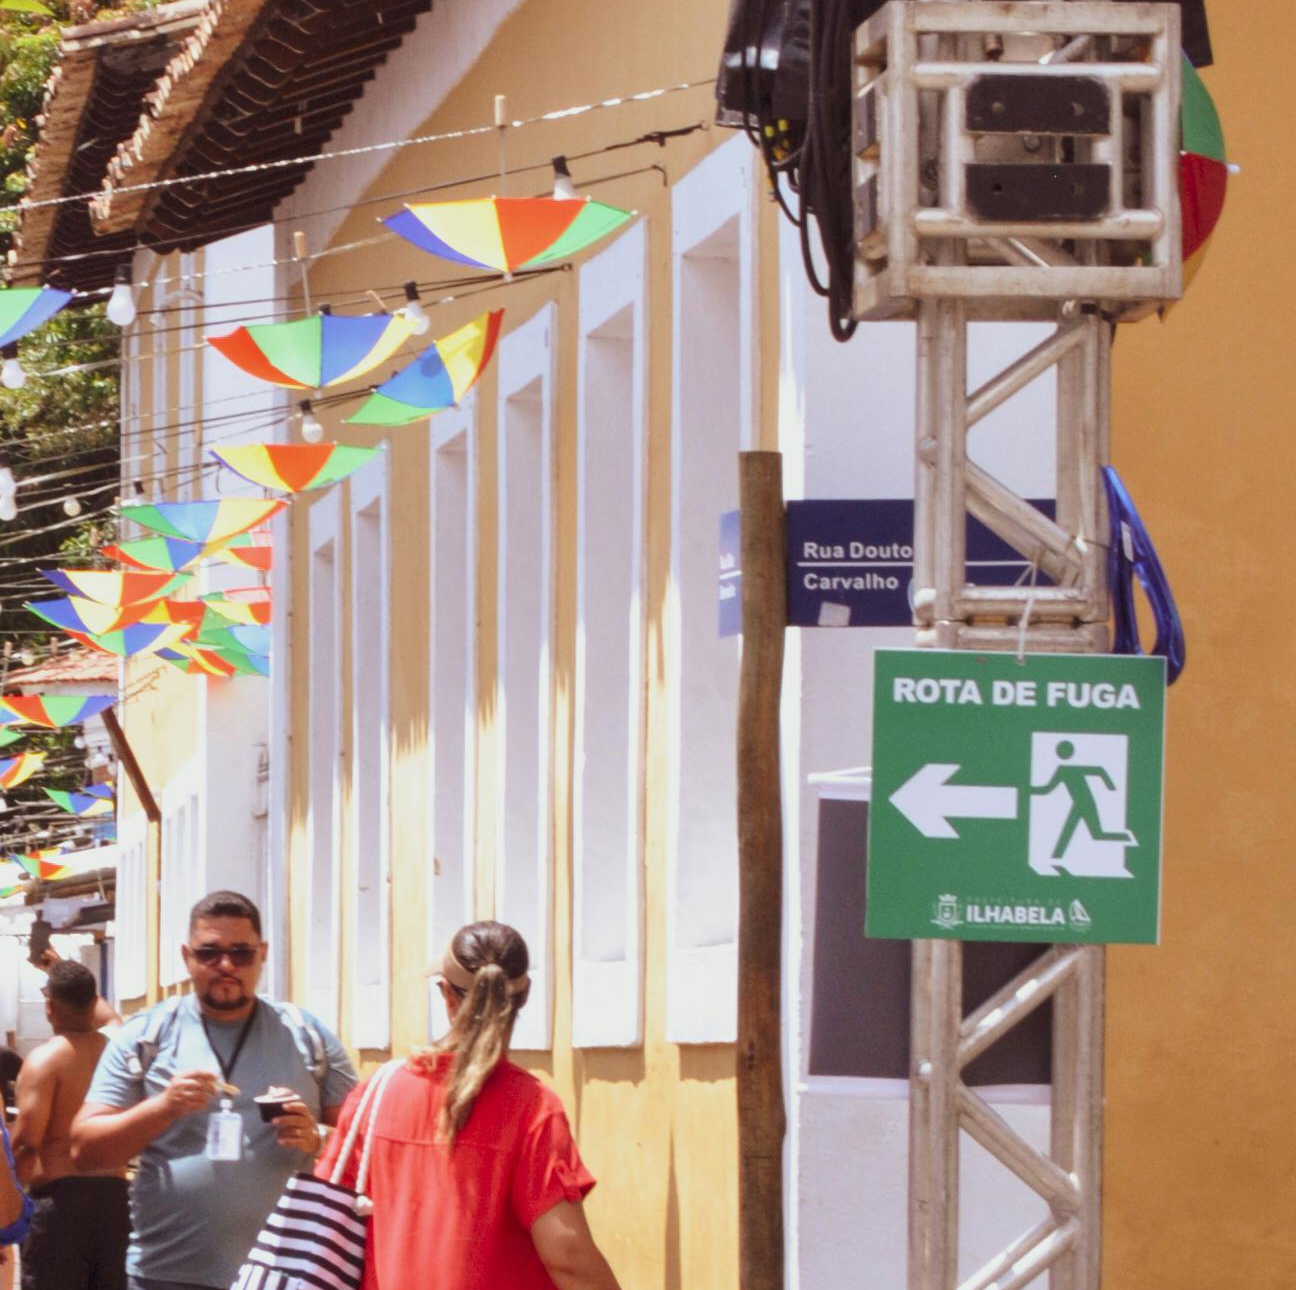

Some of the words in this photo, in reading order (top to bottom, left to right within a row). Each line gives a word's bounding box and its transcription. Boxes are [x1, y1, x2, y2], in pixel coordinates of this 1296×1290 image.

[804, 542, 844, 559] Rua
[850, 542, 914, 559] Douto
[804, 573, 899, 590] Carvalho
[893, 677, 983, 705] ROTA
[993, 680, 1037, 707] DE
[1047, 682, 1141, 709] FUGA
[966, 905, 1065, 924] ILHABELA
